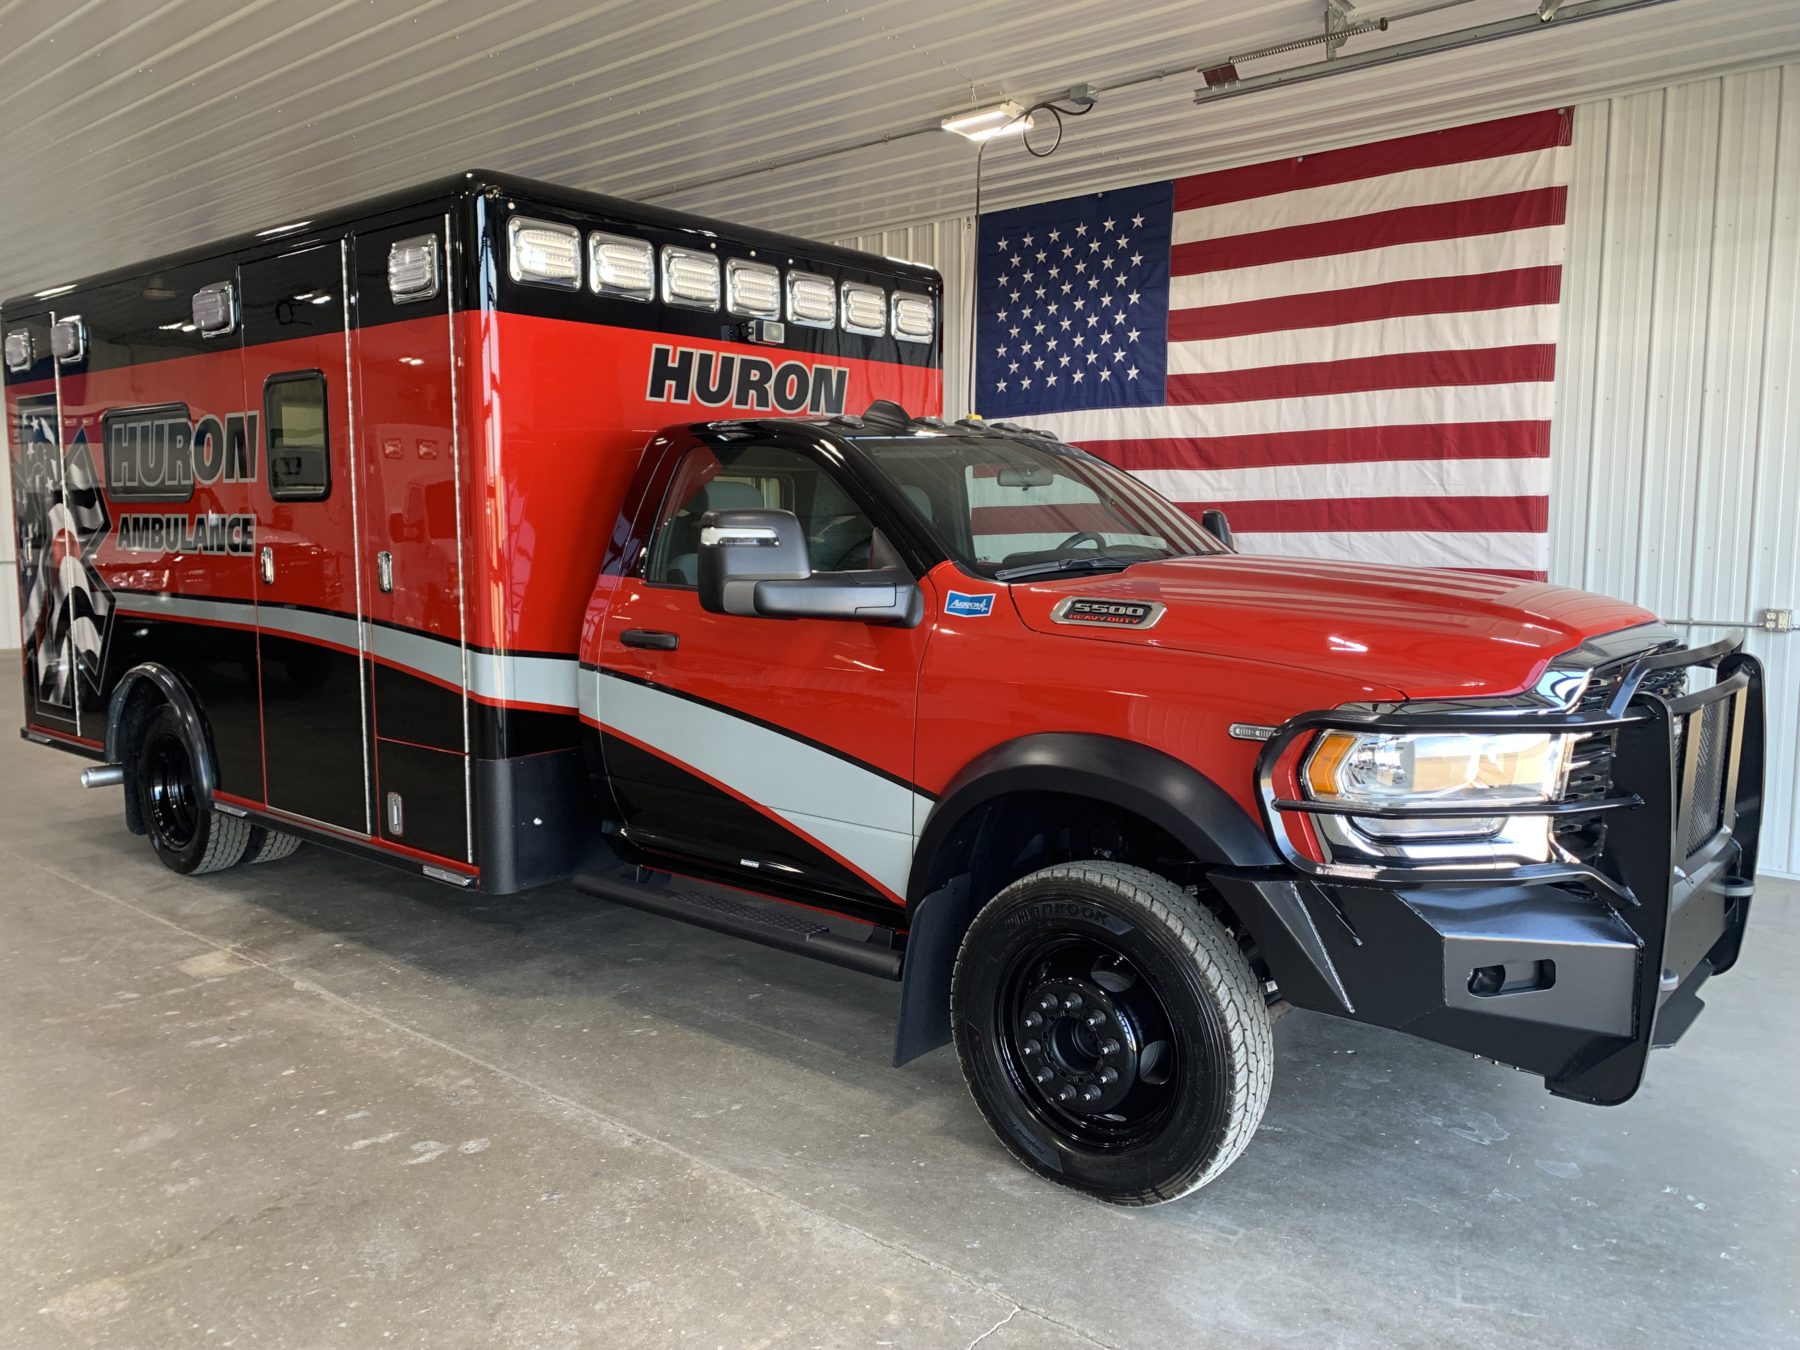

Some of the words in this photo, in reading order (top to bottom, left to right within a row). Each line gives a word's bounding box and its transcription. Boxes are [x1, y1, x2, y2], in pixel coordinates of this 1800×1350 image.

[646, 344, 849, 415] HURON
[112, 410, 259, 486] HURON
[116, 513, 256, 556] AMBULANCE
[1069, 613, 1105, 621] HEAVY
[1106, 616, 1140, 624] DUTY
[1074, 603, 1144, 616] 5500
